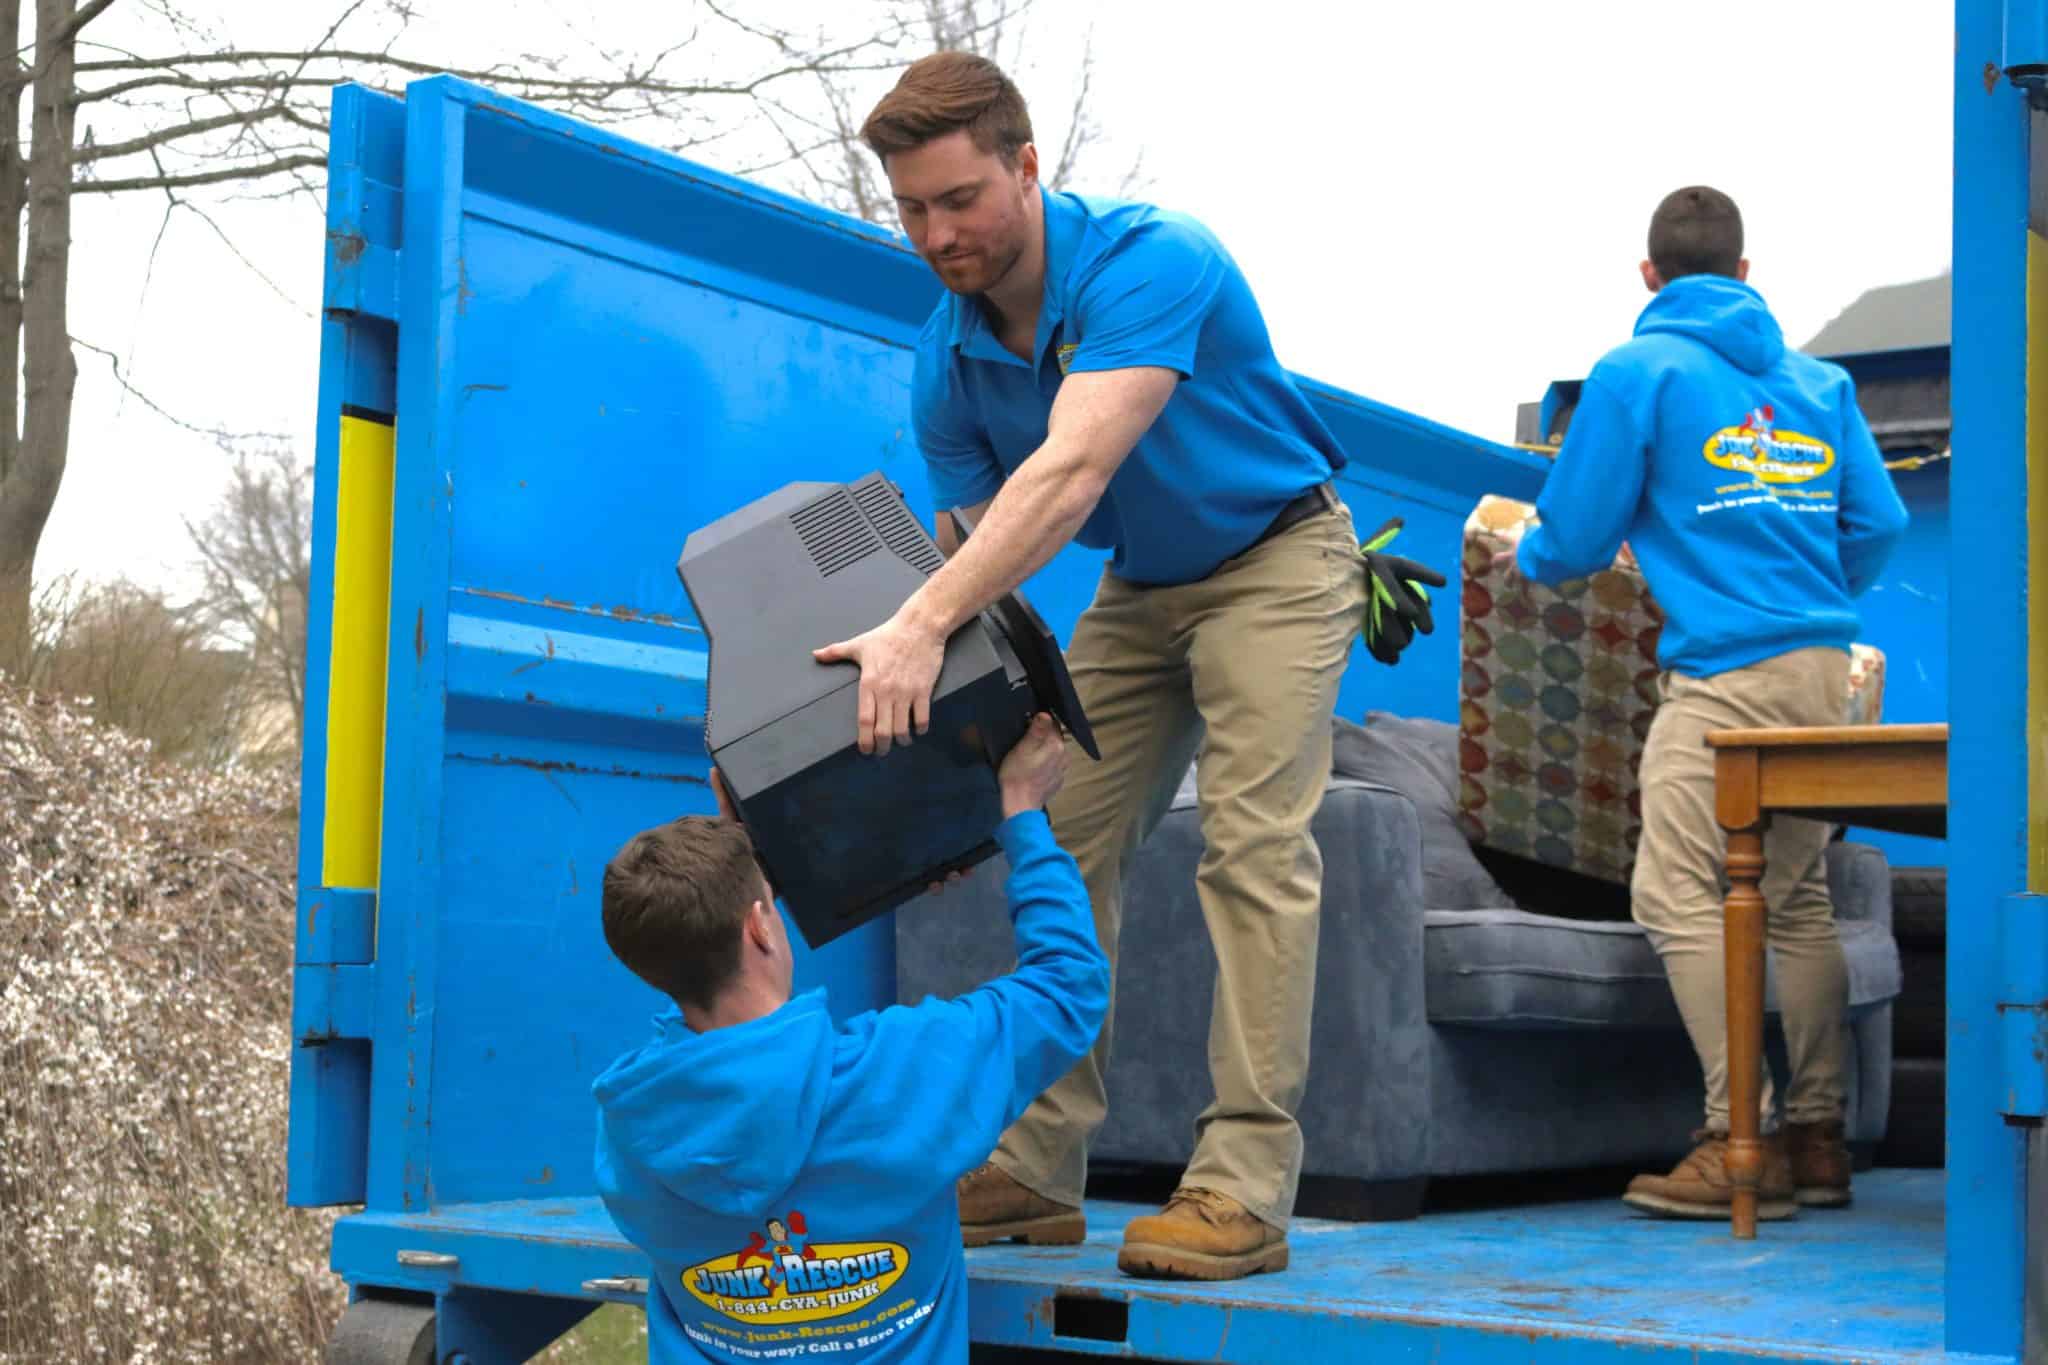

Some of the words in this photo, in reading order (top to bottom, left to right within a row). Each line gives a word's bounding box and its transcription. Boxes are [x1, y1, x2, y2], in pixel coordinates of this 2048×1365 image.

[693, 1265, 770, 1298] JUNK
[781, 1248, 895, 1295] RESCUE
[716, 1281, 881, 1315] 1-844-CYA-JUNK
[714, 1337, 728, 1349] in
[729, 1344, 761, 1359] your
[763, 1344, 805, 1358] way?
[808, 1340, 842, 1354] Call
[843, 1341, 856, 1351] a
[856, 1327, 895, 1349] Hero
